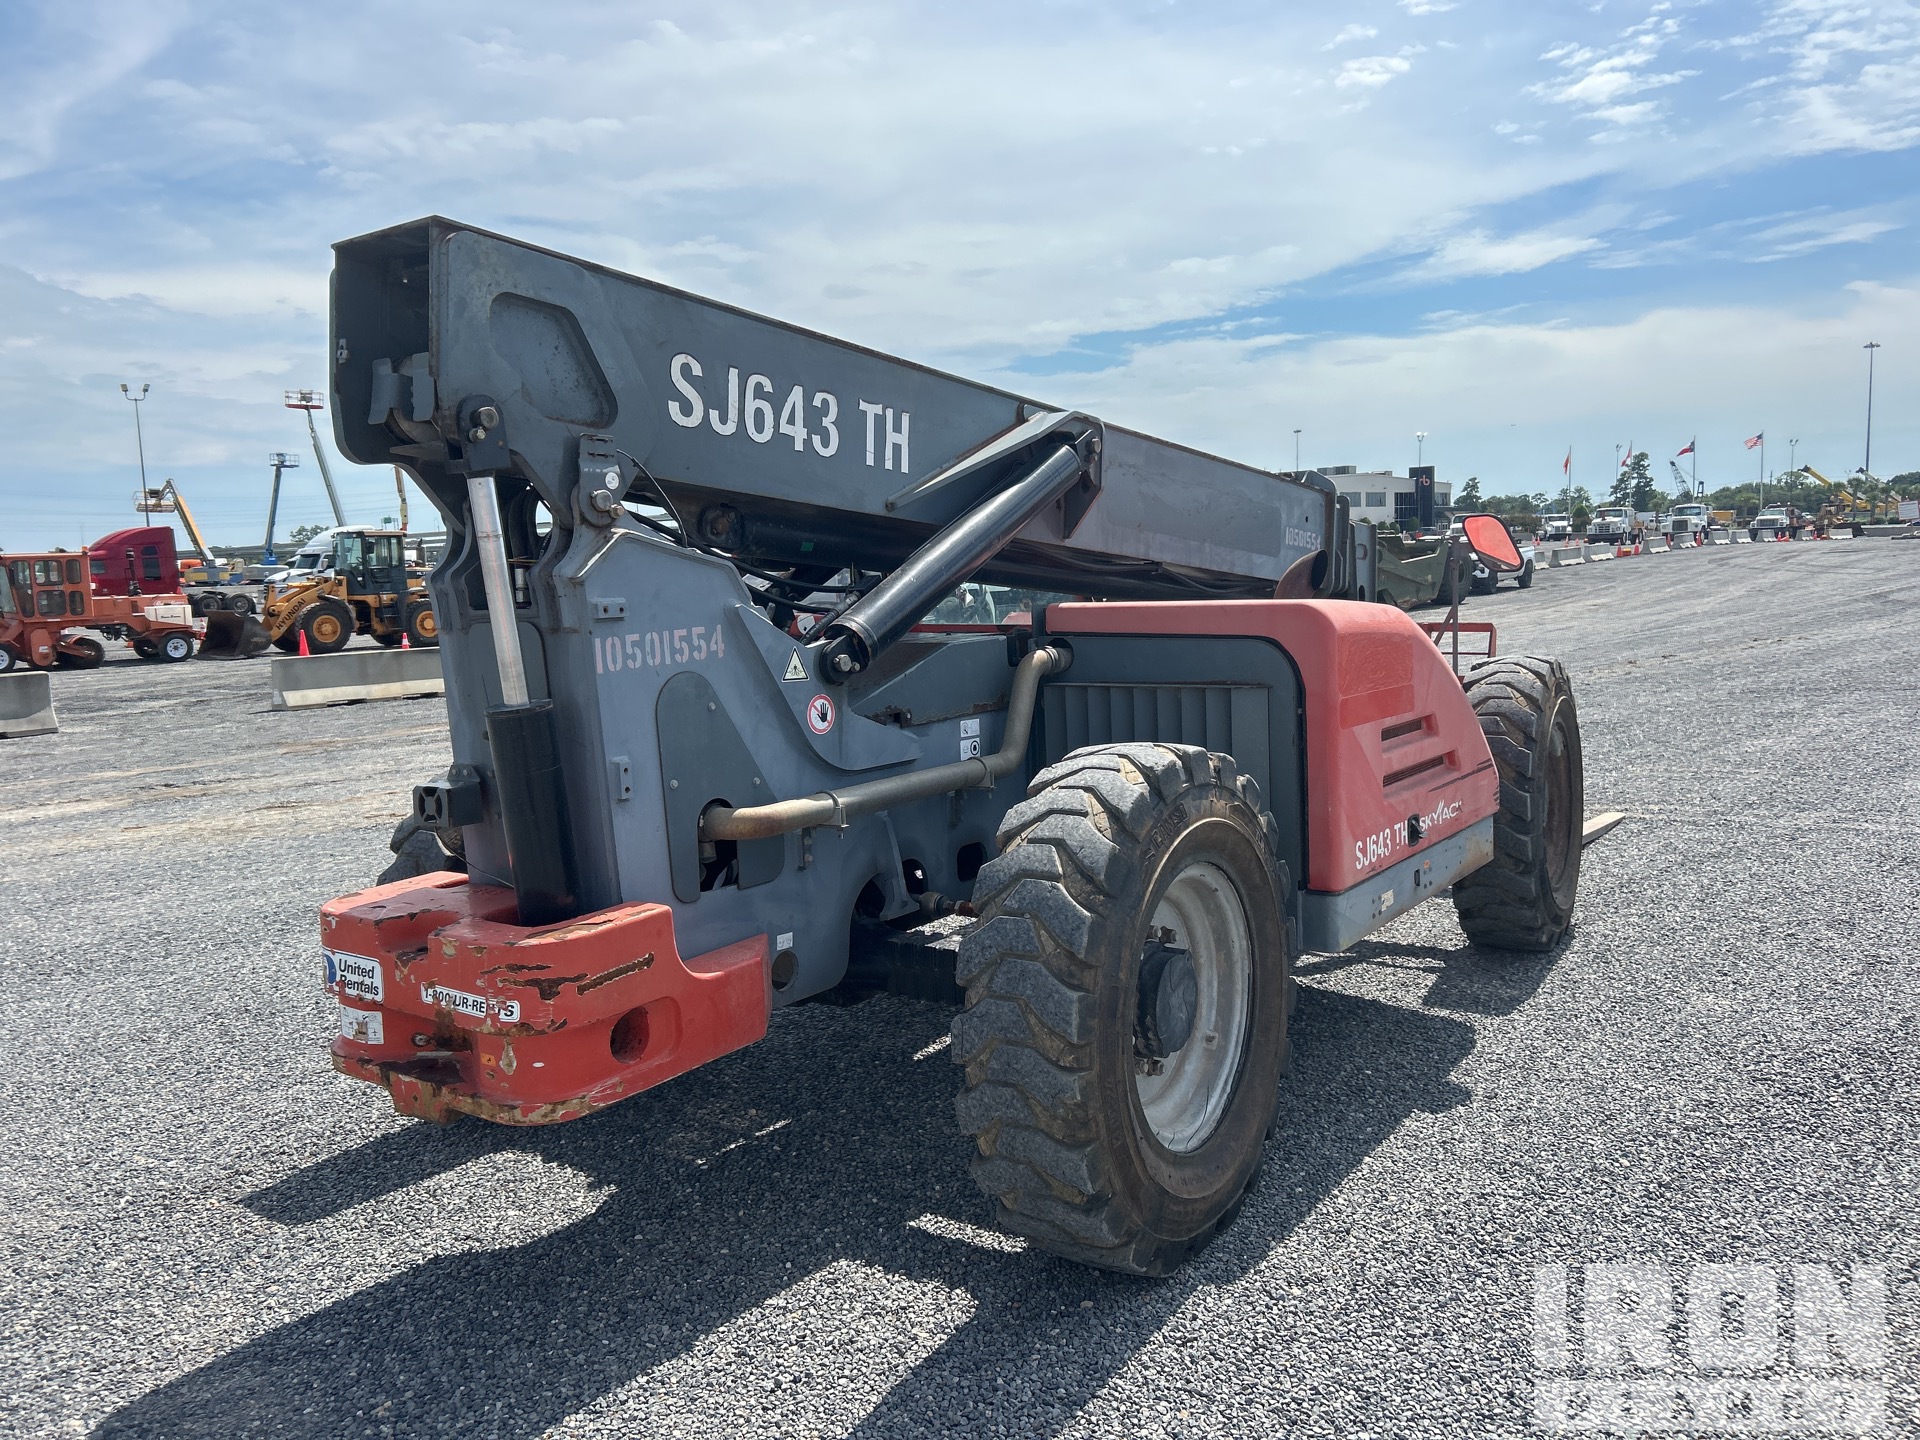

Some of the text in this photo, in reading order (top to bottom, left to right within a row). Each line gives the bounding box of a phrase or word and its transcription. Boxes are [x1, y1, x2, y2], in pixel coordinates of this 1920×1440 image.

[668, 353, 910, 473] SJ643 TH
[276, 598, 306, 630] HYUNDAI
[594, 624, 725, 674] 10501554
[1355, 819, 1408, 870] SJ643 TH
[339, 958, 375, 979] United
[340, 974, 379, 996] Rentals
[425, 988, 515, 1017] 1-800UR-RES
